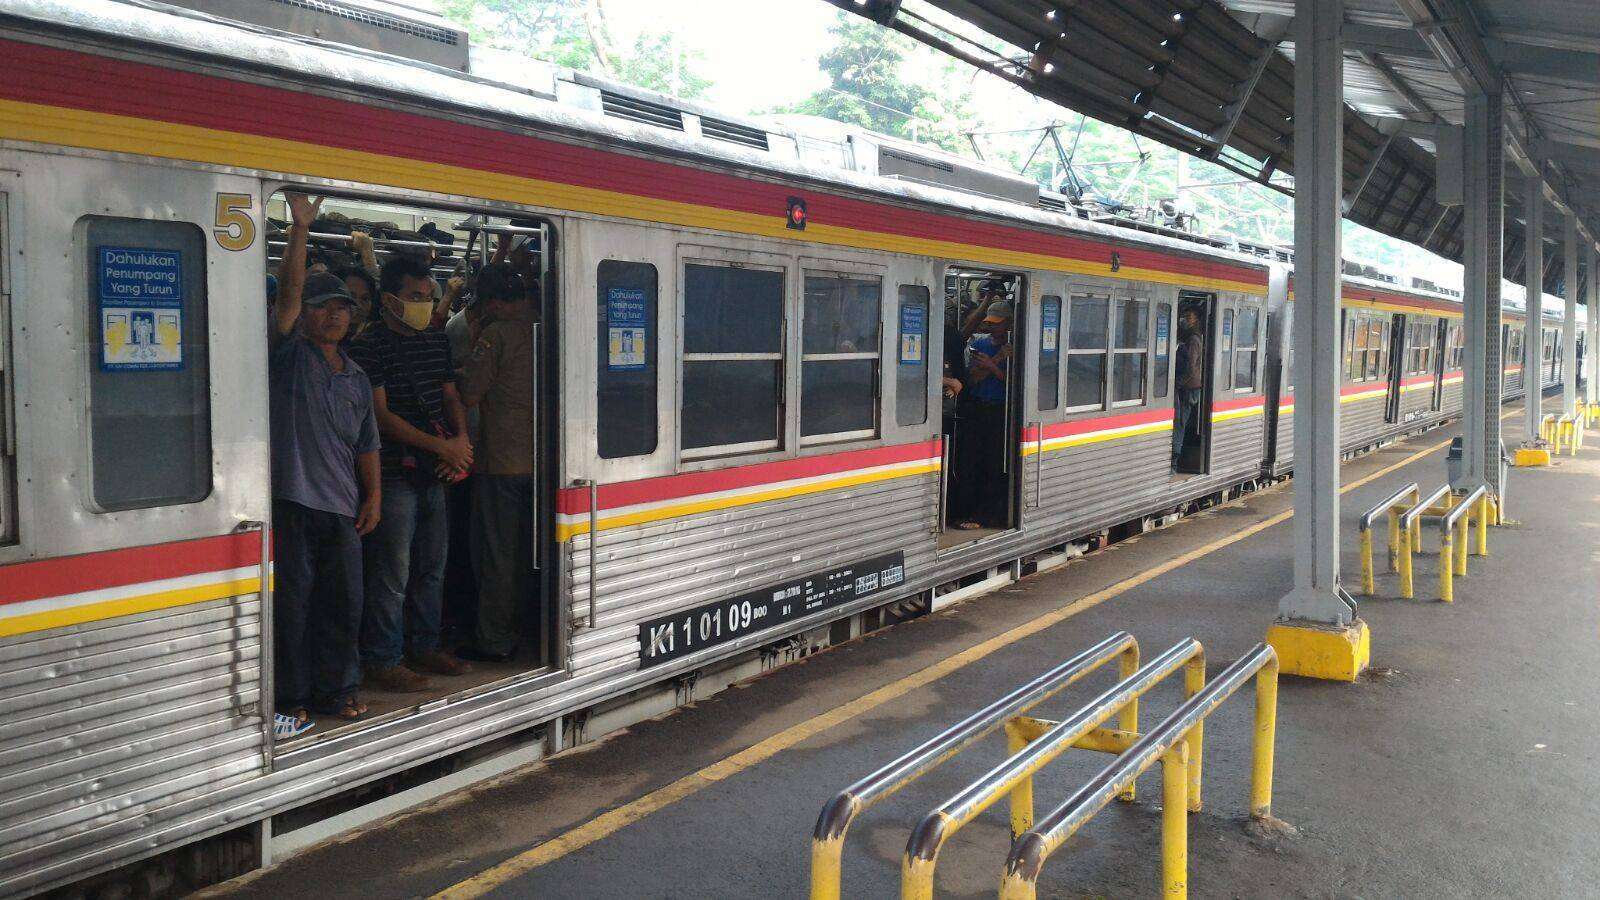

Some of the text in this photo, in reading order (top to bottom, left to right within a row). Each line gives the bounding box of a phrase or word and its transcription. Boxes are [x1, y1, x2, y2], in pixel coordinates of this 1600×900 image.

[213, 191, 256, 251] 5
[106, 251, 175, 266] Dahulukan
[106, 267, 176, 283] Penumpang
[111, 282, 173, 295] Yang Turun
